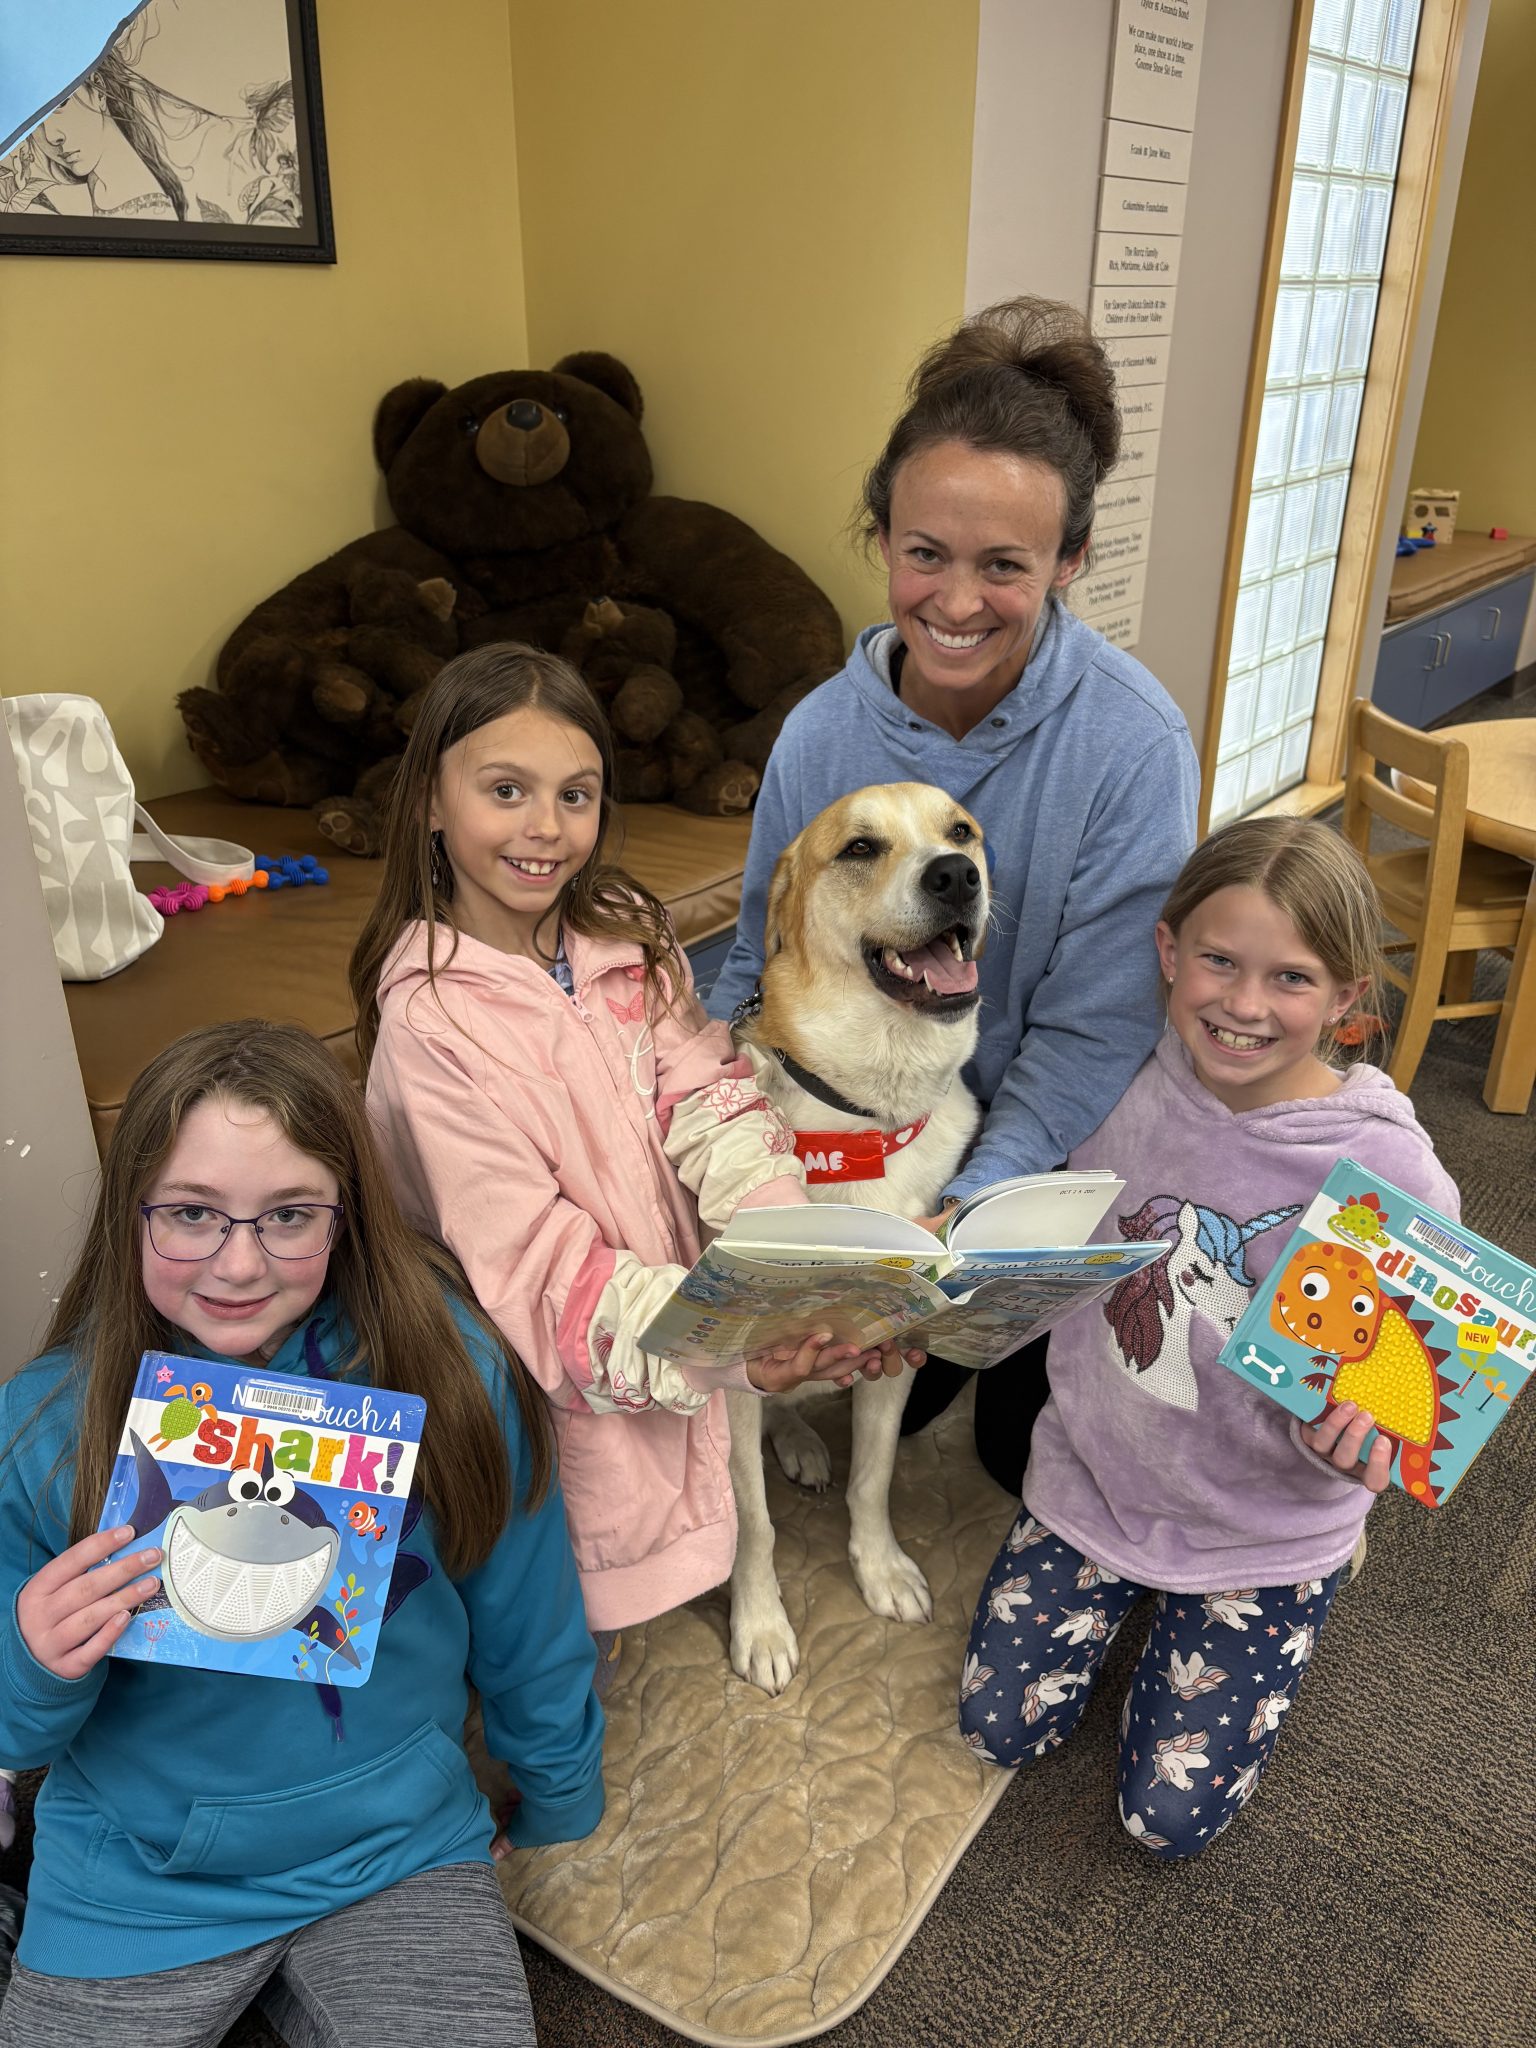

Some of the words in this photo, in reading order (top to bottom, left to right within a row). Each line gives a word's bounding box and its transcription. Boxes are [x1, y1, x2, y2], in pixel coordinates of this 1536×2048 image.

[1128, 24, 1136, 37] We
[1136, 29, 1145, 38] can
[1145, 31, 1157, 42] make
[1157, 35, 1165, 44] our
[1165, 36, 1178, 47] world
[1147, 48, 1156, 57] one
[1156, 48, 1167, 59] shoe
[1146, 201, 1169, 213] Foundation
[804, 1151, 844, 1172] ME
[1465, 1331, 1490, 1345] NEW
[388, 1409, 401, 1432] A
[192, 1415, 405, 1495] shark!
